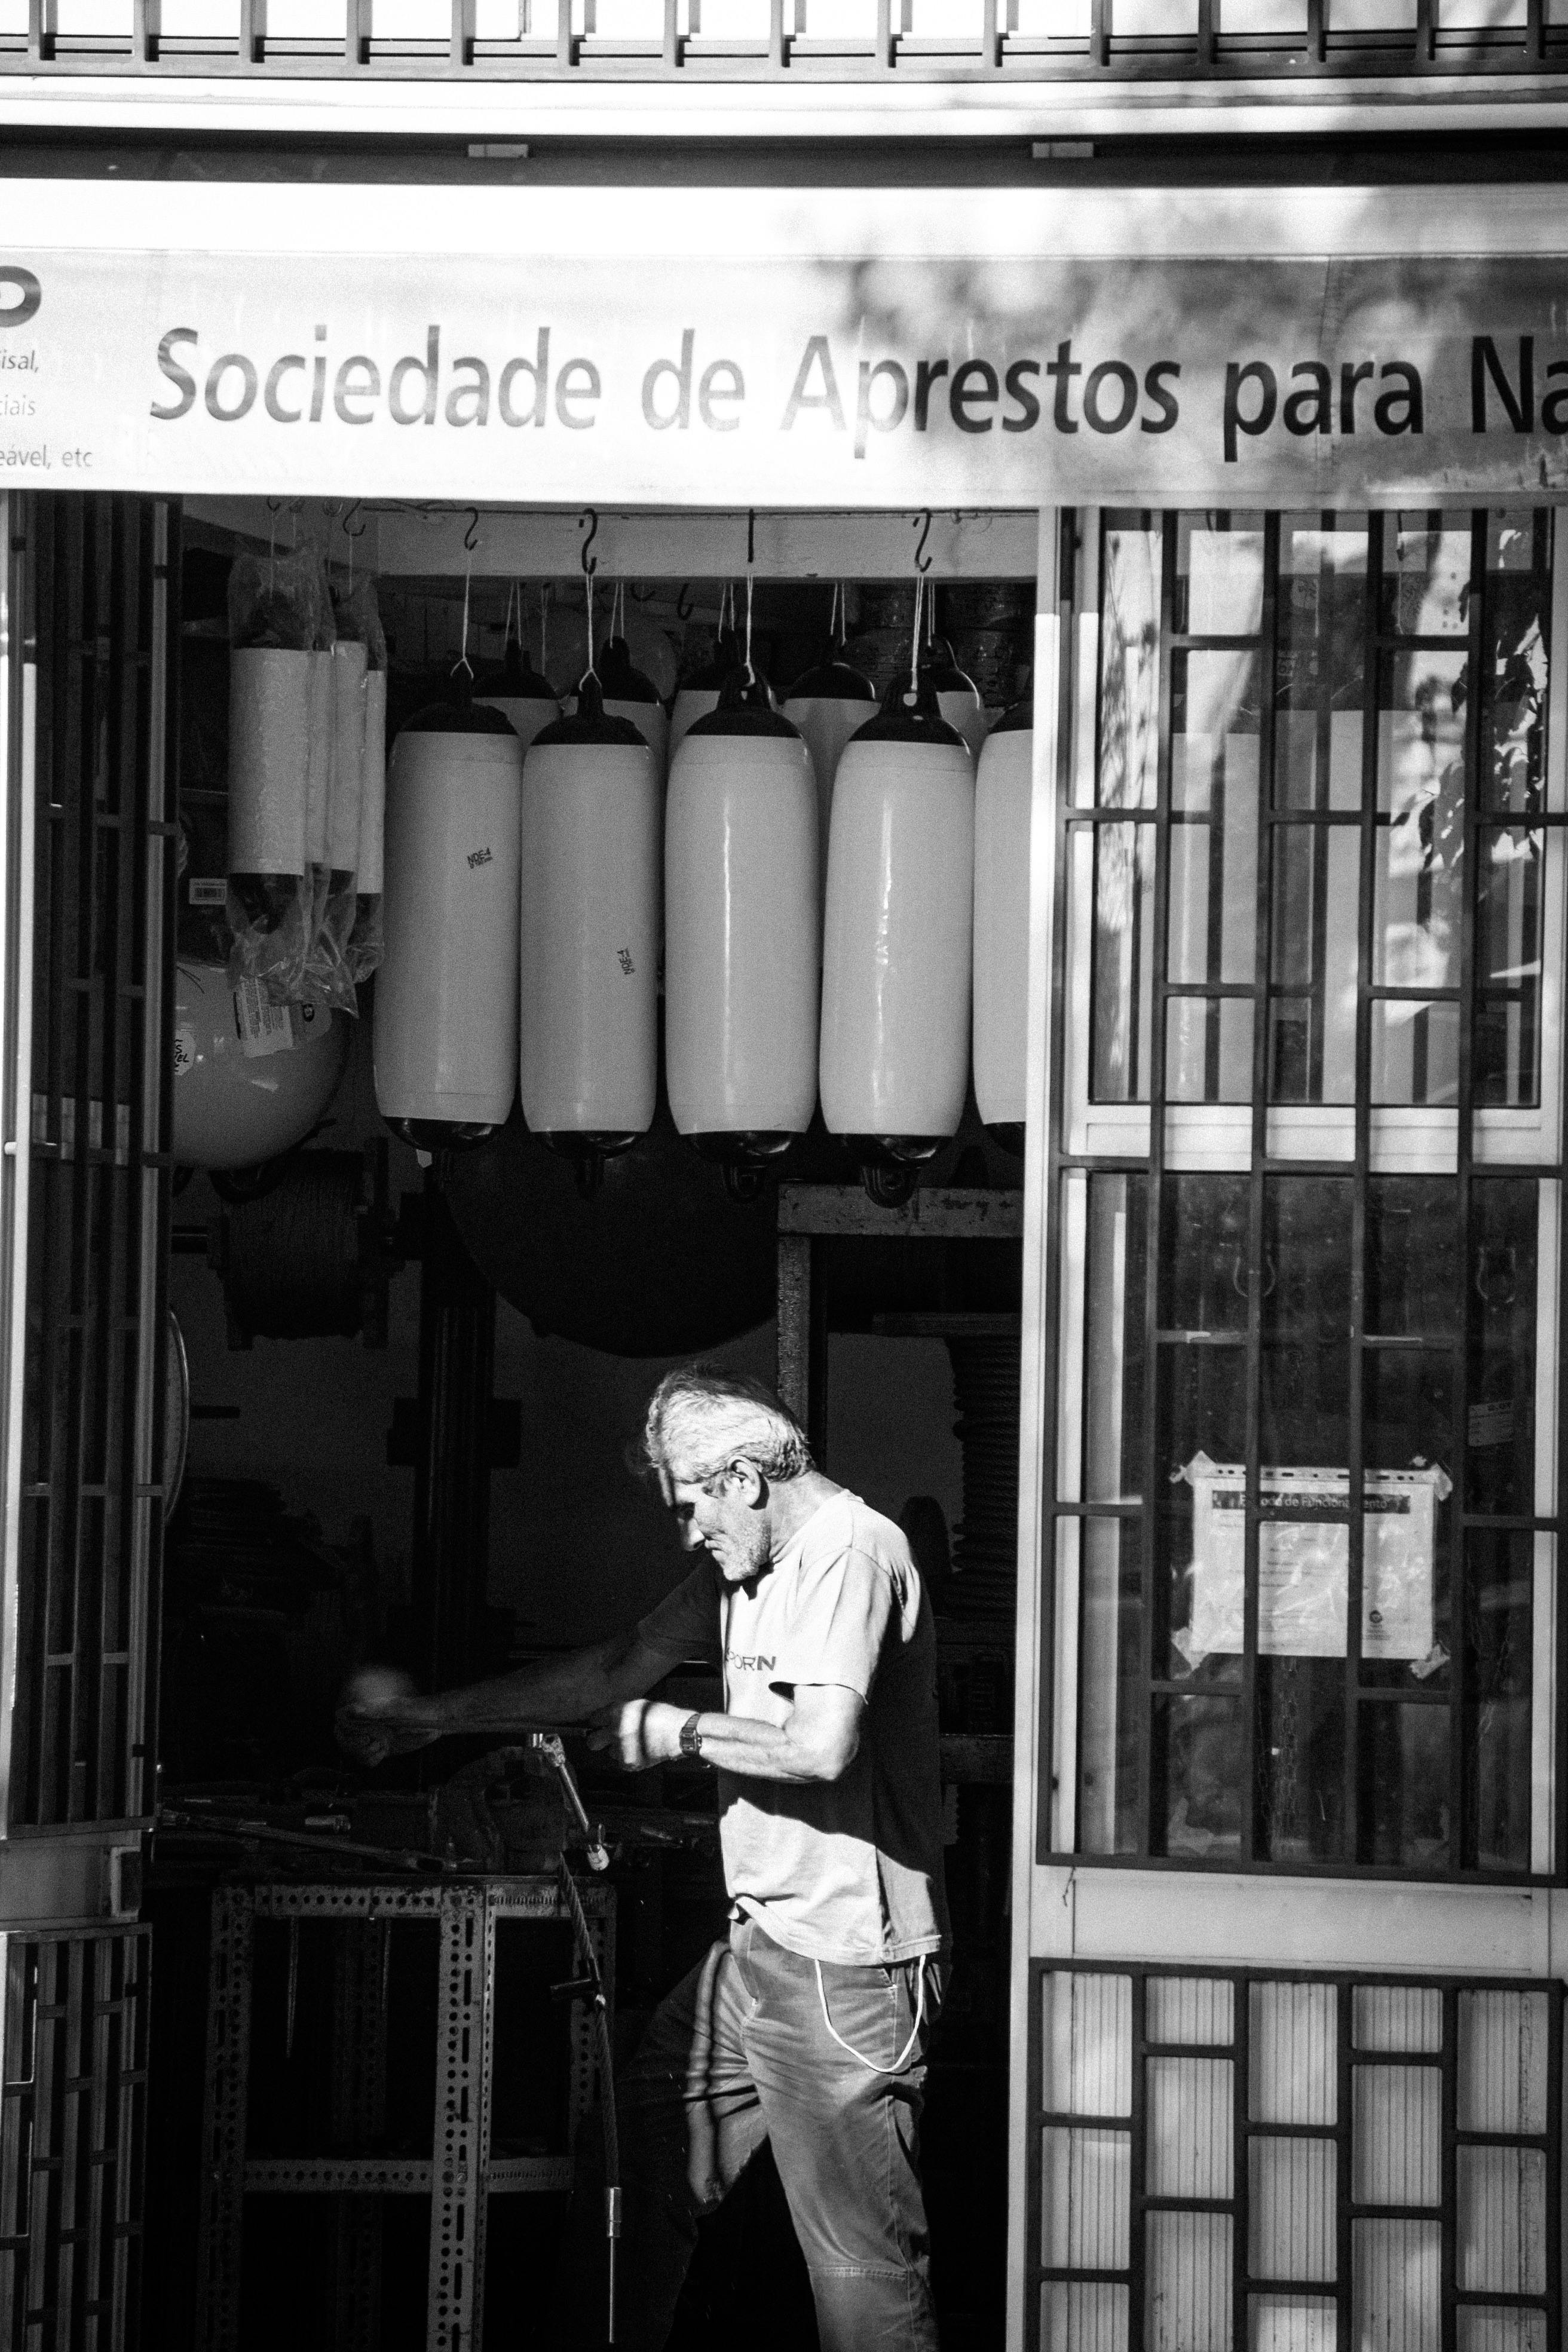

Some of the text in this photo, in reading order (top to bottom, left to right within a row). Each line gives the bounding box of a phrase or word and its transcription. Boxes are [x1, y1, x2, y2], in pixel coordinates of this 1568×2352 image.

[150, 324, 601, 430] Sociedade
[641, 327, 746, 432] de
[779, 335, 1181, 460] Aprestos
[1224, 360, 1424, 463] para
[62, 449, 93, 467] etc
